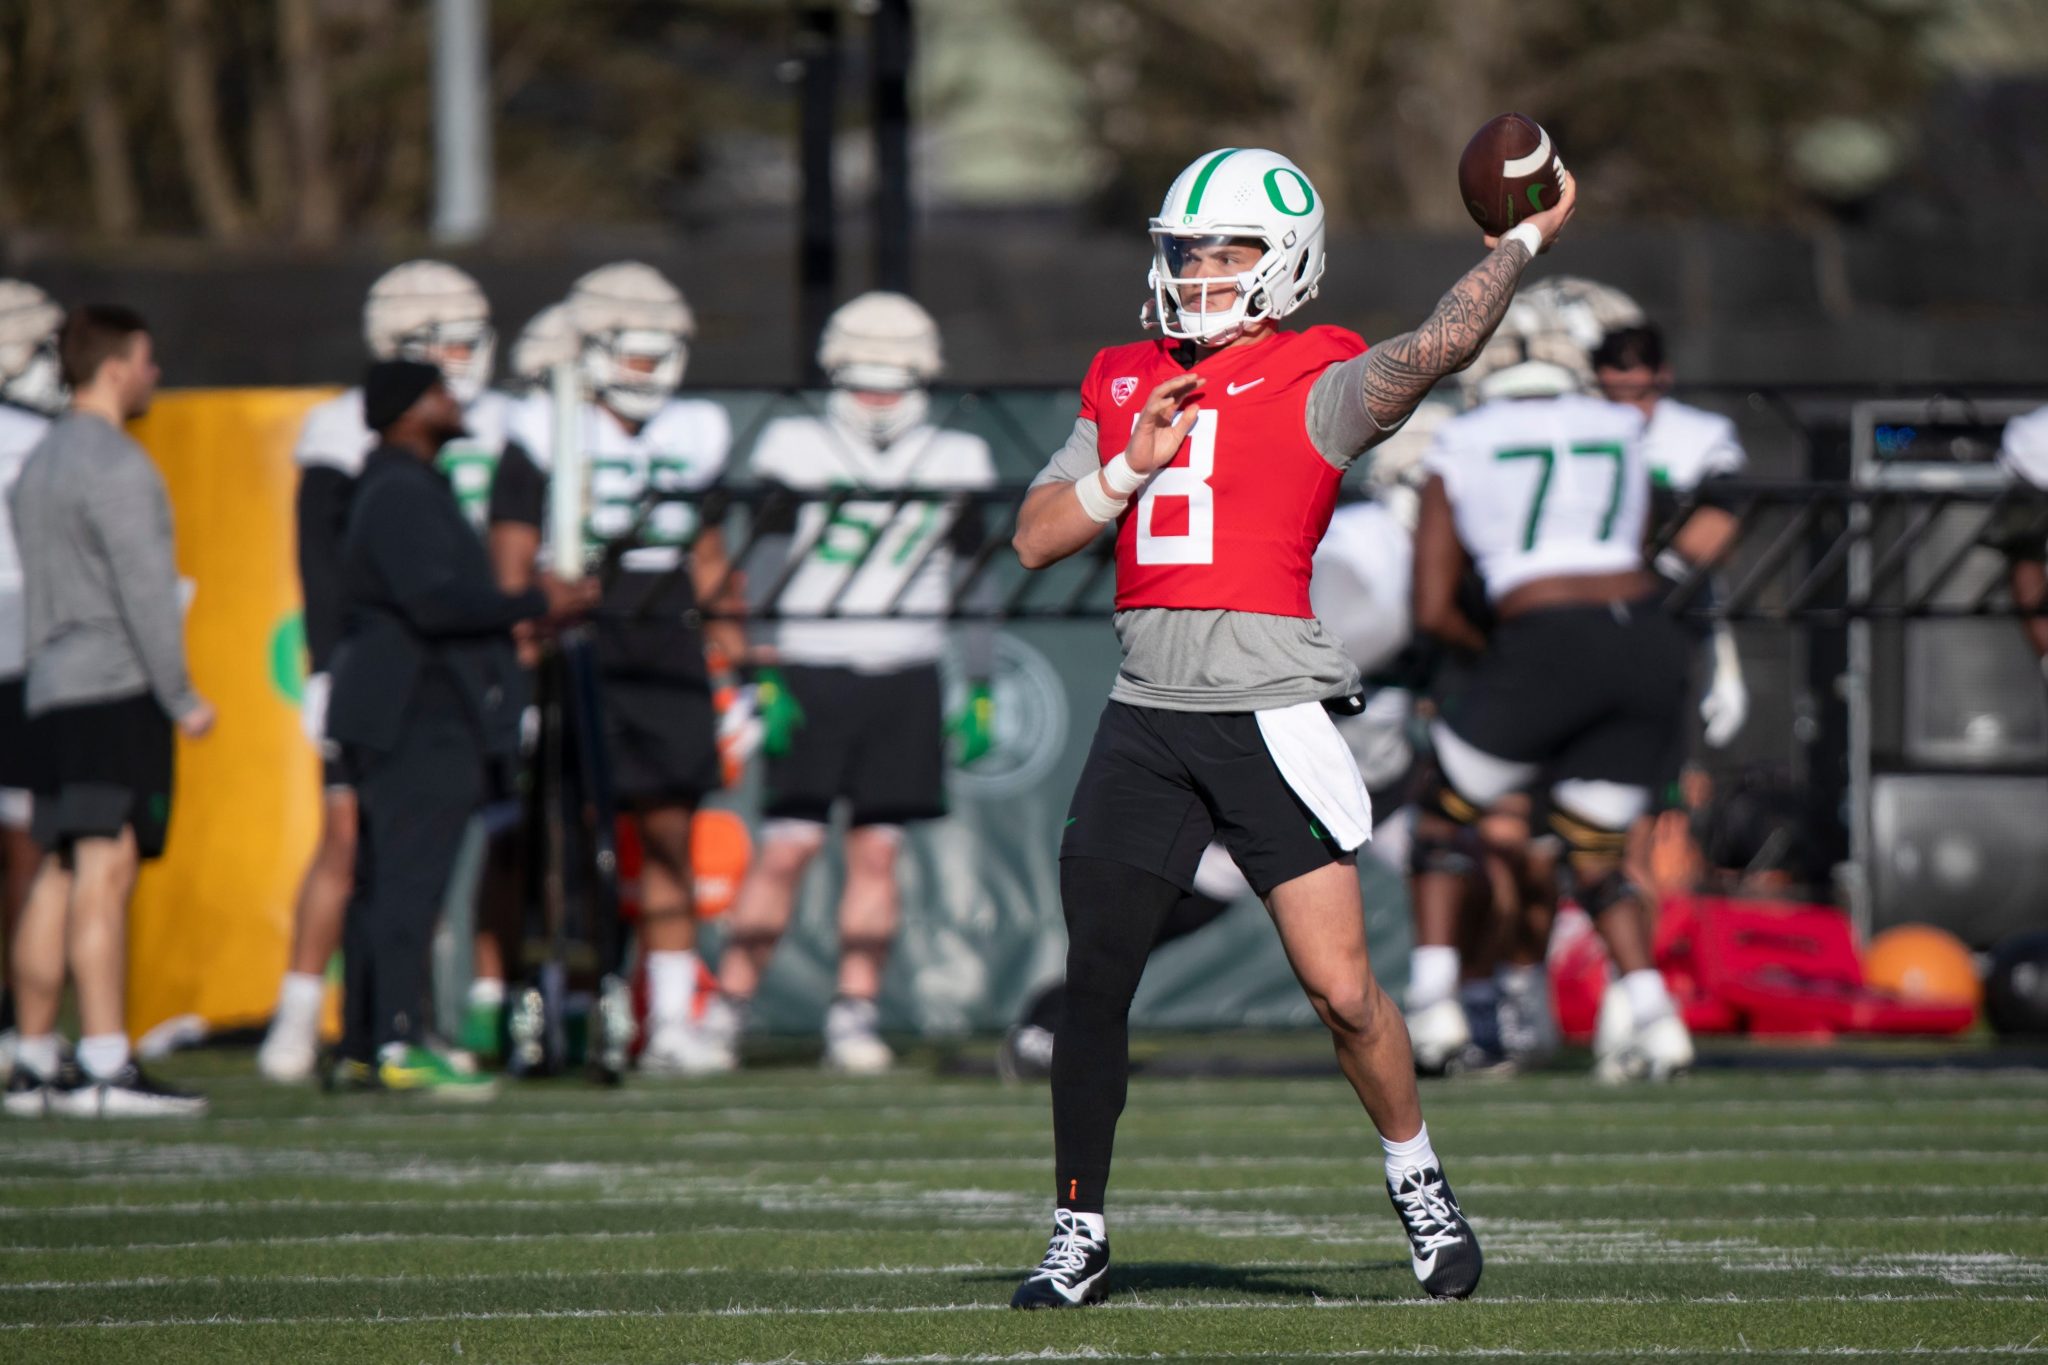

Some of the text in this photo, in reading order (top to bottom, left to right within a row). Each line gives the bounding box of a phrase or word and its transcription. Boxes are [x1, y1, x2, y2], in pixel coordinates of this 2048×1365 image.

[1263, 167, 1315, 217] O
[1131, 409, 1218, 566] 8
[1494, 443, 1623, 554] 77
